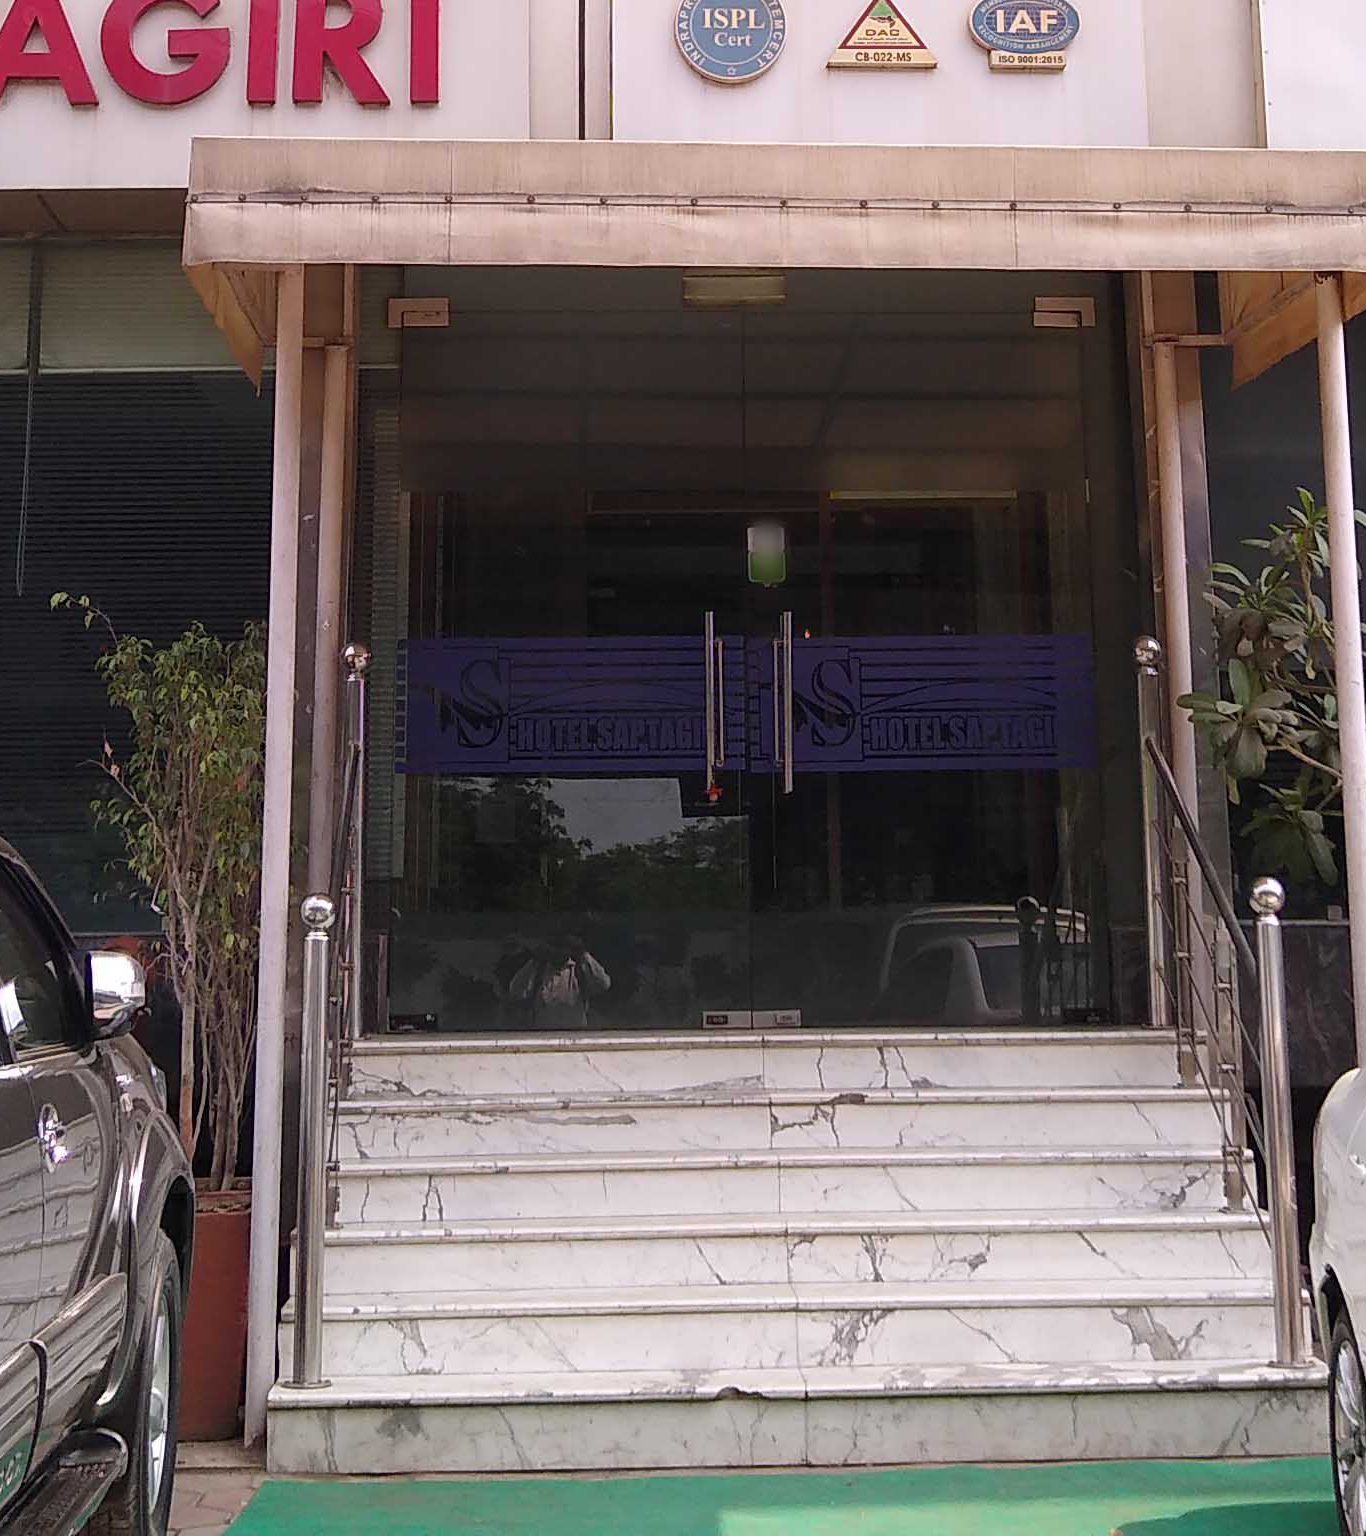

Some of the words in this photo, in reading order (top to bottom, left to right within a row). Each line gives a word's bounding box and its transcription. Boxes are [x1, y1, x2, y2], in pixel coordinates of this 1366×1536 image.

[702, 8, 765, 29] ISPL
[996, 9, 1058, 33] IAF
[714, 32, 752, 47] Cert
[854, 52, 912, 62] CB-022-MS
[998, 55, 1015, 64] ISO
[1017, 55, 1064, 64] 9001:2015
[517, 716, 591, 752] HOTEL
[869, 716, 945, 751] HOTEL
